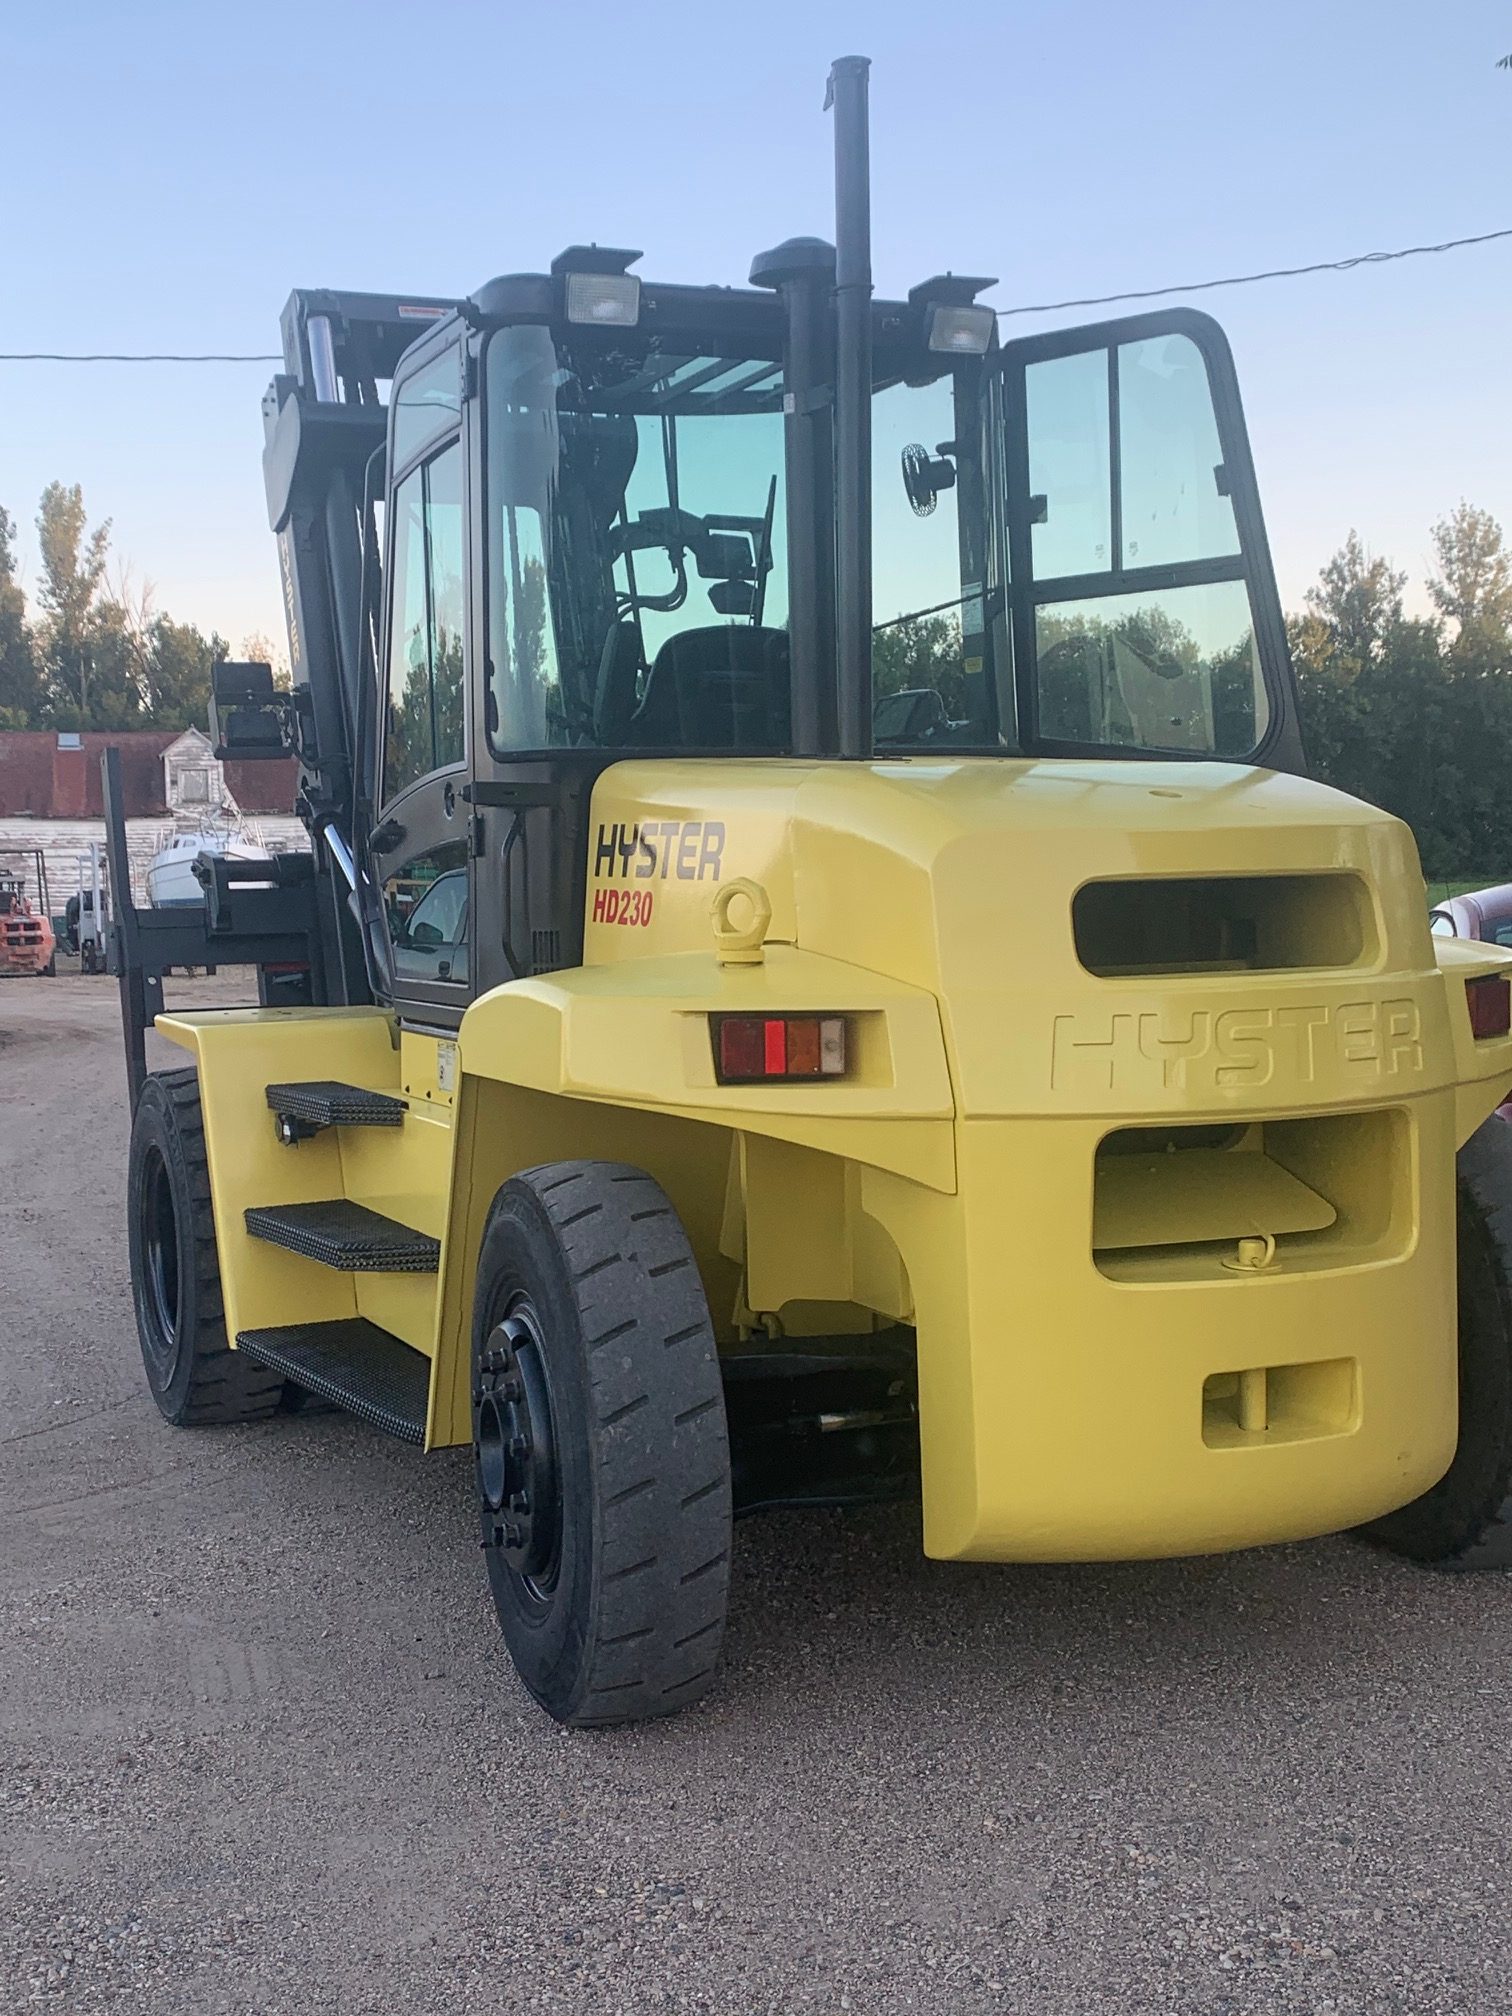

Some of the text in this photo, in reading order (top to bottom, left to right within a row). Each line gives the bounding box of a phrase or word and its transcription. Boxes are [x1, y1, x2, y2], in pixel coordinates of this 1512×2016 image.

[594, 822, 726, 881] HYSTER
[592, 889, 653, 927] HD230
[1051, 998, 1423, 1089] HYSTER
